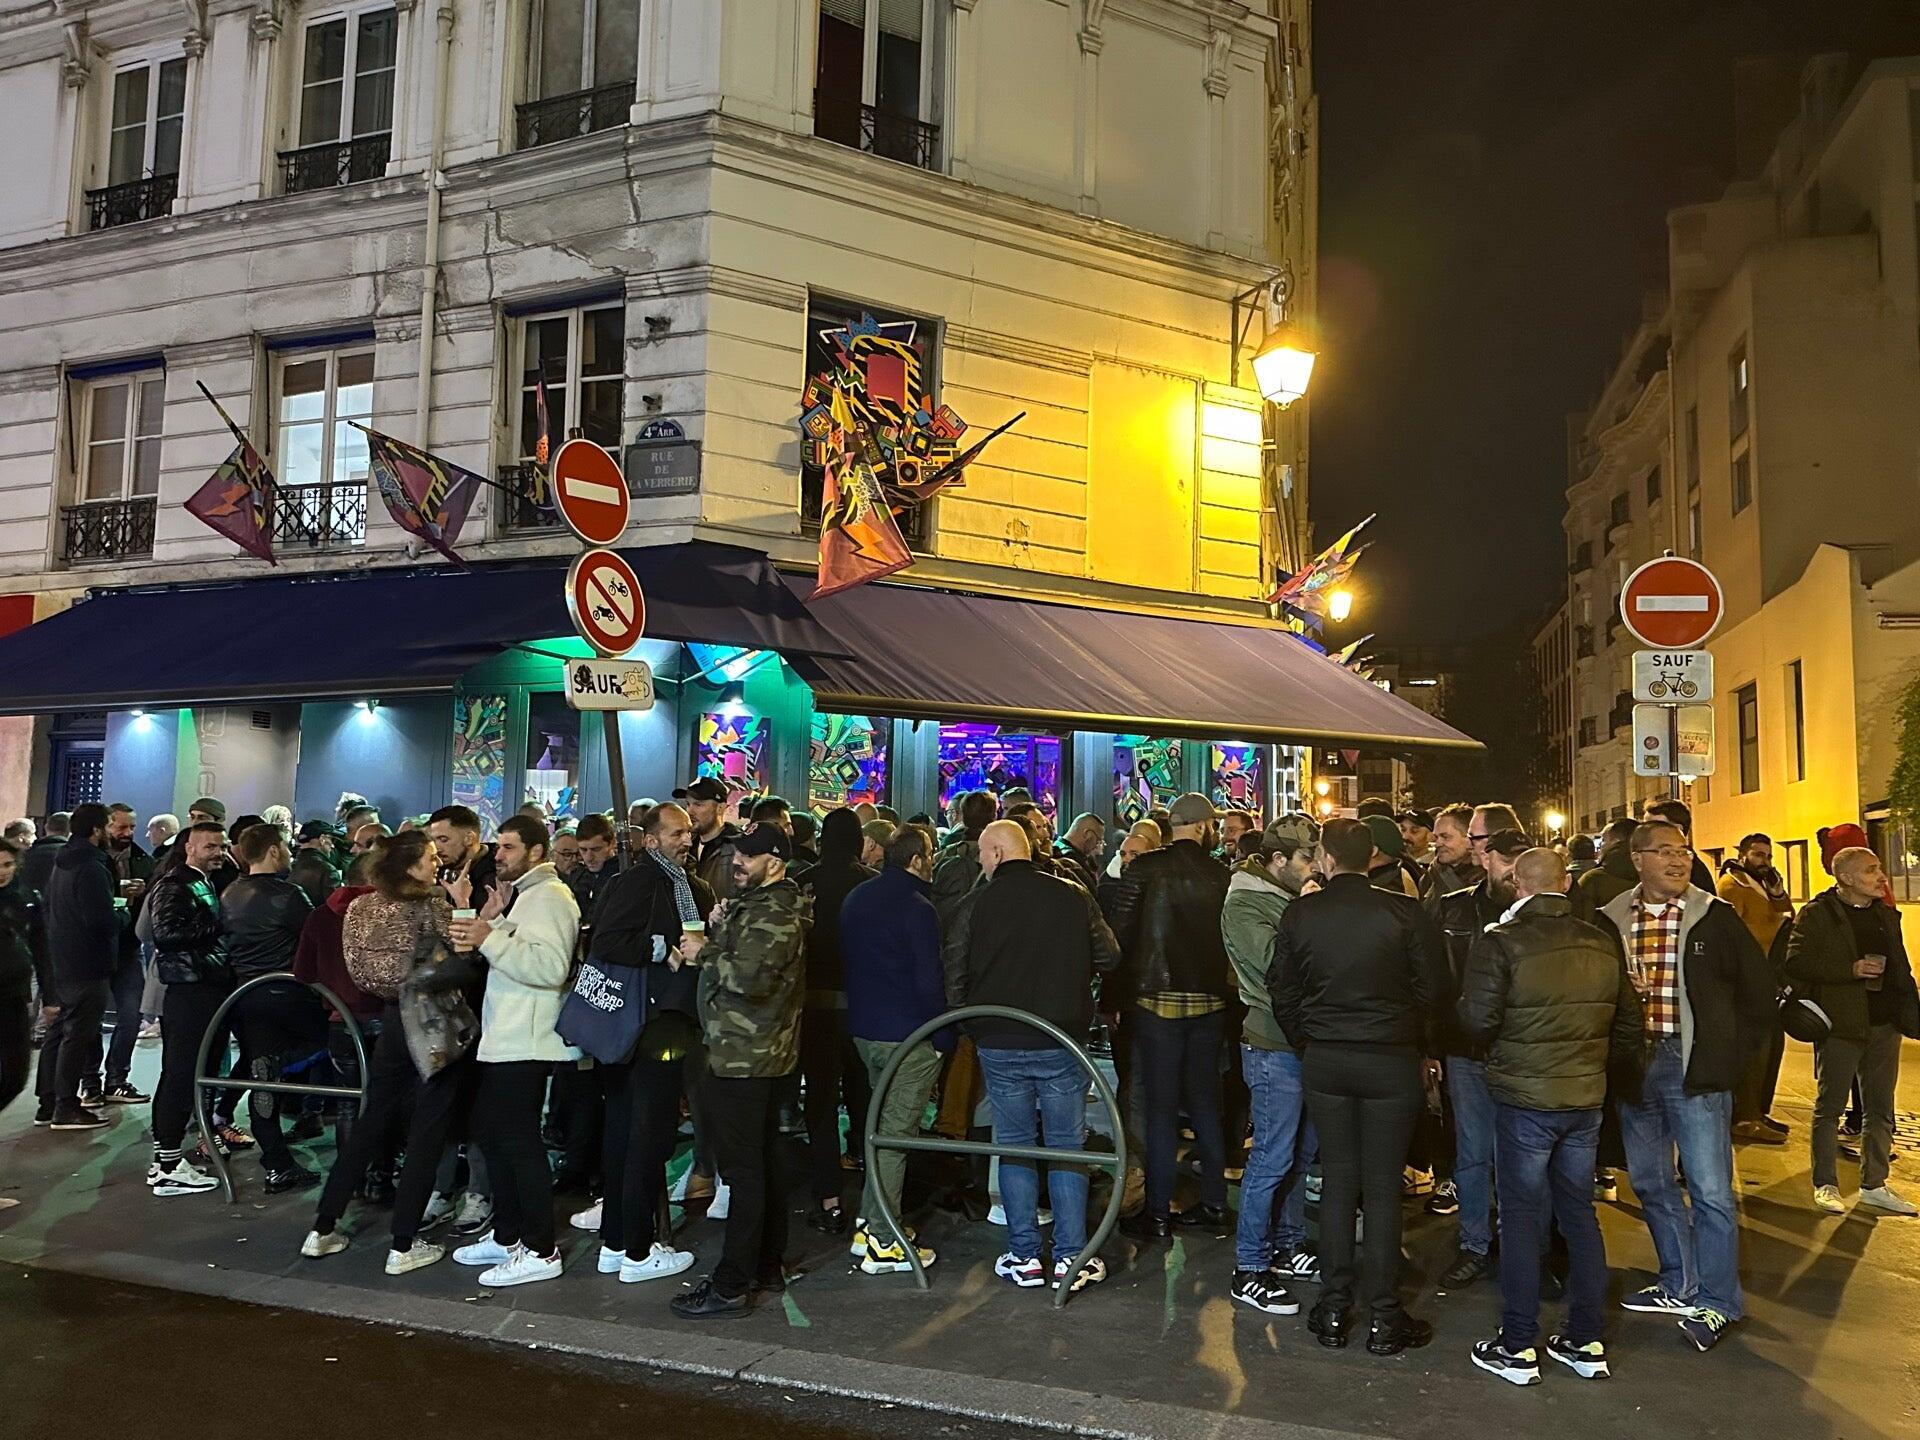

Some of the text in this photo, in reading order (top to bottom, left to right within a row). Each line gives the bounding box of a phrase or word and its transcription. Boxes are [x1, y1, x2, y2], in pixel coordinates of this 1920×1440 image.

[651, 451, 674, 462] RUE
[654, 465, 669, 475] DE
[629, 476, 695, 489] LA VERRERIE
[1652, 654, 1694, 667] SAUF
[574, 674, 617, 694] SAUF
[582, 963, 623, 990] DISCIPINE
[586, 973, 603, 989] NOT
[574, 985, 591, 999] RON
[589, 993, 617, 1012] DORFF
[577, 977, 598, 994] DIRTY
[597, 988, 624, 1008] WORD
